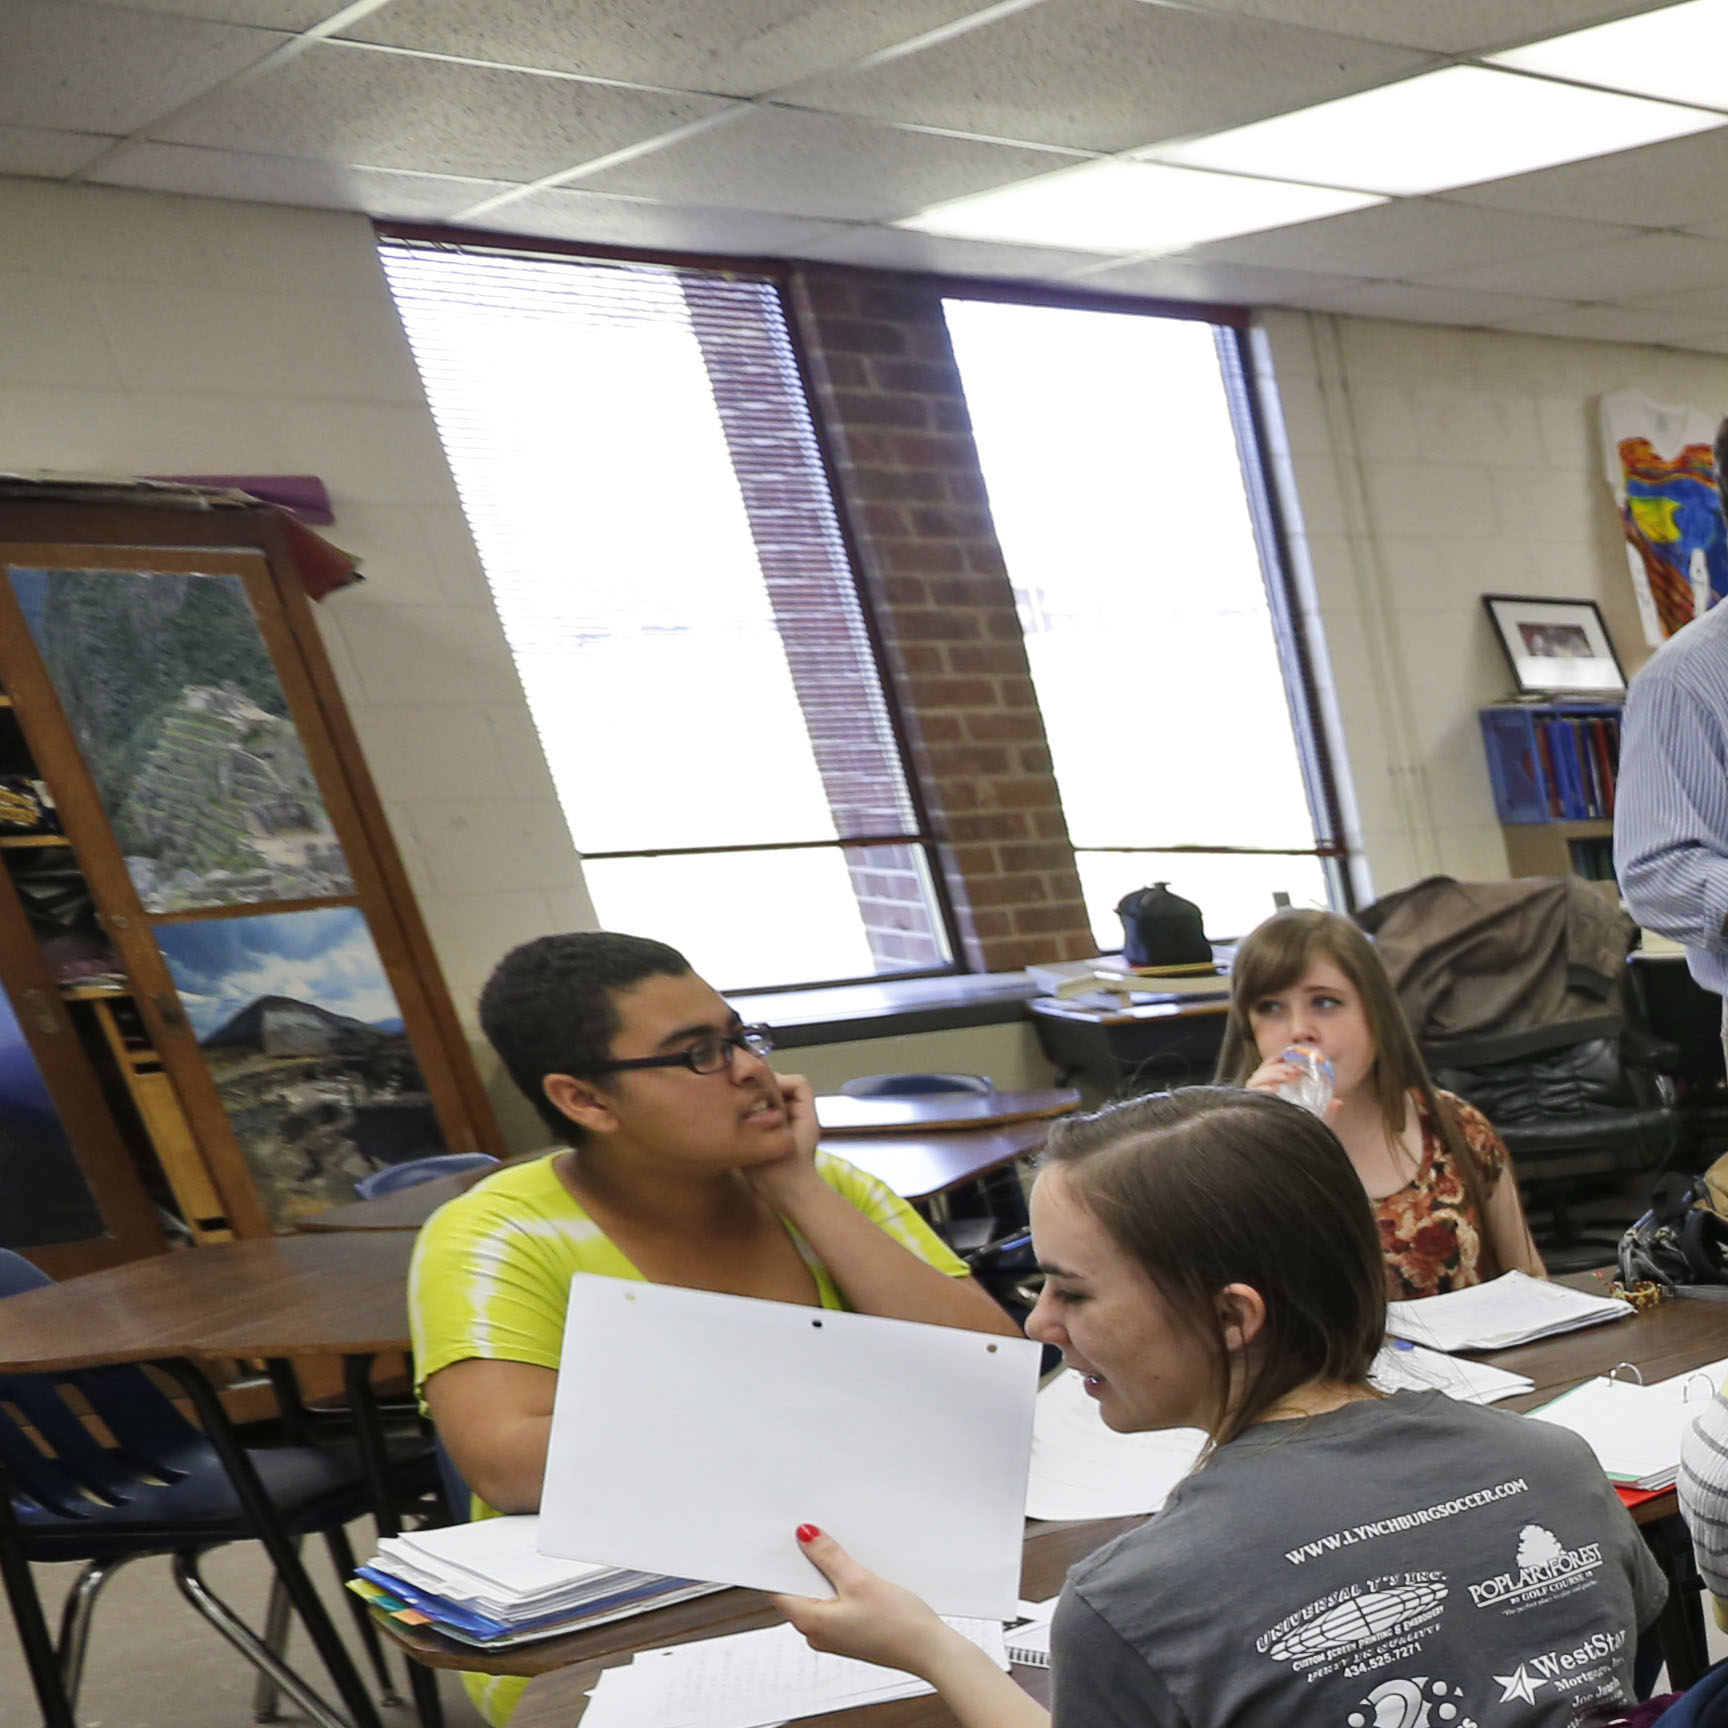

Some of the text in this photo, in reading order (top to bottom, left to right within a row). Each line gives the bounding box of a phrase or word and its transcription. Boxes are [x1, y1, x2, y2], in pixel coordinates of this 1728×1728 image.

[1285, 1478, 1529, 1565] WWW.LYNCHBURGSOCCER.COM
[1550, 1542, 1602, 1577] FOREST
[1522, 1587, 1548, 1602] GOLF
[1550, 1575, 1586, 1593] COURSE
[1256, 1584, 1362, 1653] UNIVERSAL
[1292, 1654, 1326, 1671] CUSTOM
[1327, 1642, 1358, 1661] SCREEN
[1358, 1630, 1393, 1648] PRINTING
[1343, 1643, 1422, 1678] 434.525.7271
[1530, 1630, 1625, 1679] WestStar
